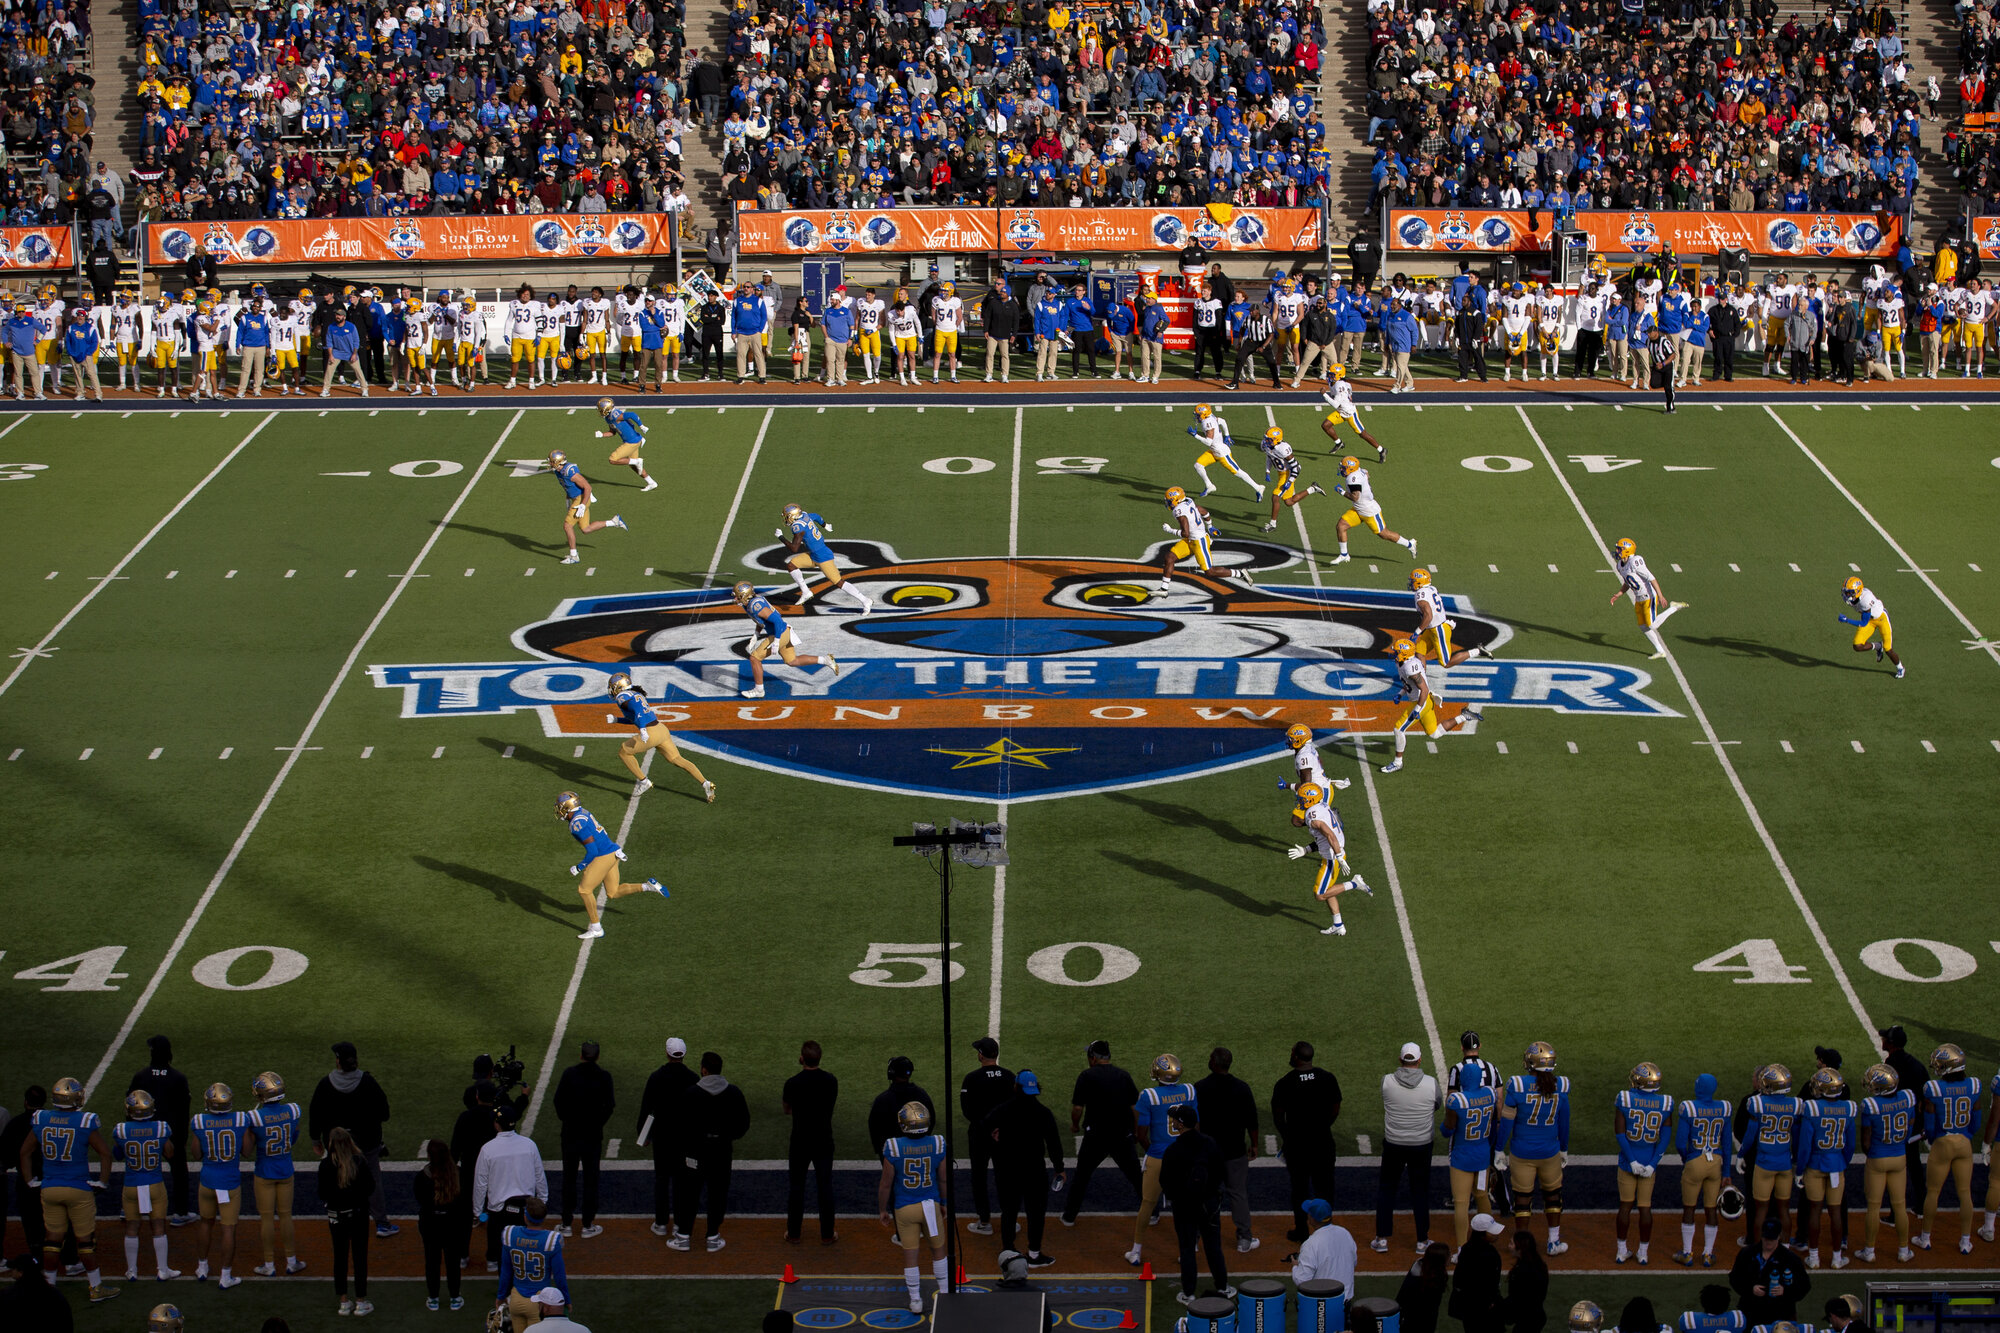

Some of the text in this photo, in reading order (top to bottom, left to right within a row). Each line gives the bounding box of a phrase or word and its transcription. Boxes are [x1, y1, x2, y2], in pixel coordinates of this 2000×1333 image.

[791, 224, 806, 235] ACC
[1059, 225, 1138, 235] SUN BOWL
[1158, 221, 1174, 233] ACC
[1405, 222, 1419, 233] ACC
[1776, 226, 1791, 237] ACC
[168, 234, 183, 247] ACC
[440, 234, 519, 244] SUN BOWL
[923, 228, 982, 248] Visit EL PASO
[1290, 225, 1315, 247] Visit
[1674, 229, 1753, 241] SUN BOWL
[302, 237, 362, 258] Visit EL PASO
[1145, 276, 1153, 286] G
[1775, 295, 1790, 310] 50
[1966, 301, 1981, 315] 93
[515, 309, 531, 323] 53
[565, 311, 581, 325] 47
[588, 309, 603, 324] 37
[665, 309, 677, 323] 51
[861, 309, 877, 324] 29
[938, 308, 953, 323] 54
[1512, 304, 1519, 318] 4
[1543, 305, 1557, 320] 48
[1590, 306, 1597, 320] 8
[1881, 310, 1898, 325] 22
[624, 312, 639, 326] 24
[158, 322, 169, 337] 11
[279, 327, 292, 342] 14
[407, 660, 1638, 711] TONY THE TIGER
[653, 703, 1378, 725] SUN BOWL
[1301, 758, 1309, 766] 31
[1526, 1092, 1560, 1126] 77
[1765, 1102, 1794, 1113] THOMAS
[1881, 1099, 1907, 1113] JUSTICE
[1943, 1096, 1971, 1130] 18
[1464, 1106, 1494, 1141] 27
[1626, 1108, 1662, 1144] 39
[1760, 1114, 1794, 1145] 29
[1882, 1111, 1908, 1145] 19
[266, 1123, 292, 1157] 21
[1693, 1117, 1724, 1150] 30
[1817, 1117, 1847, 1150] 31
[41, 1126, 76, 1162] 67
[204, 1129, 236, 1163] 10
[124, 1139, 160, 1172] 96
[903, 1156, 933, 1189] 51
[509, 1248, 546, 1282] 93
